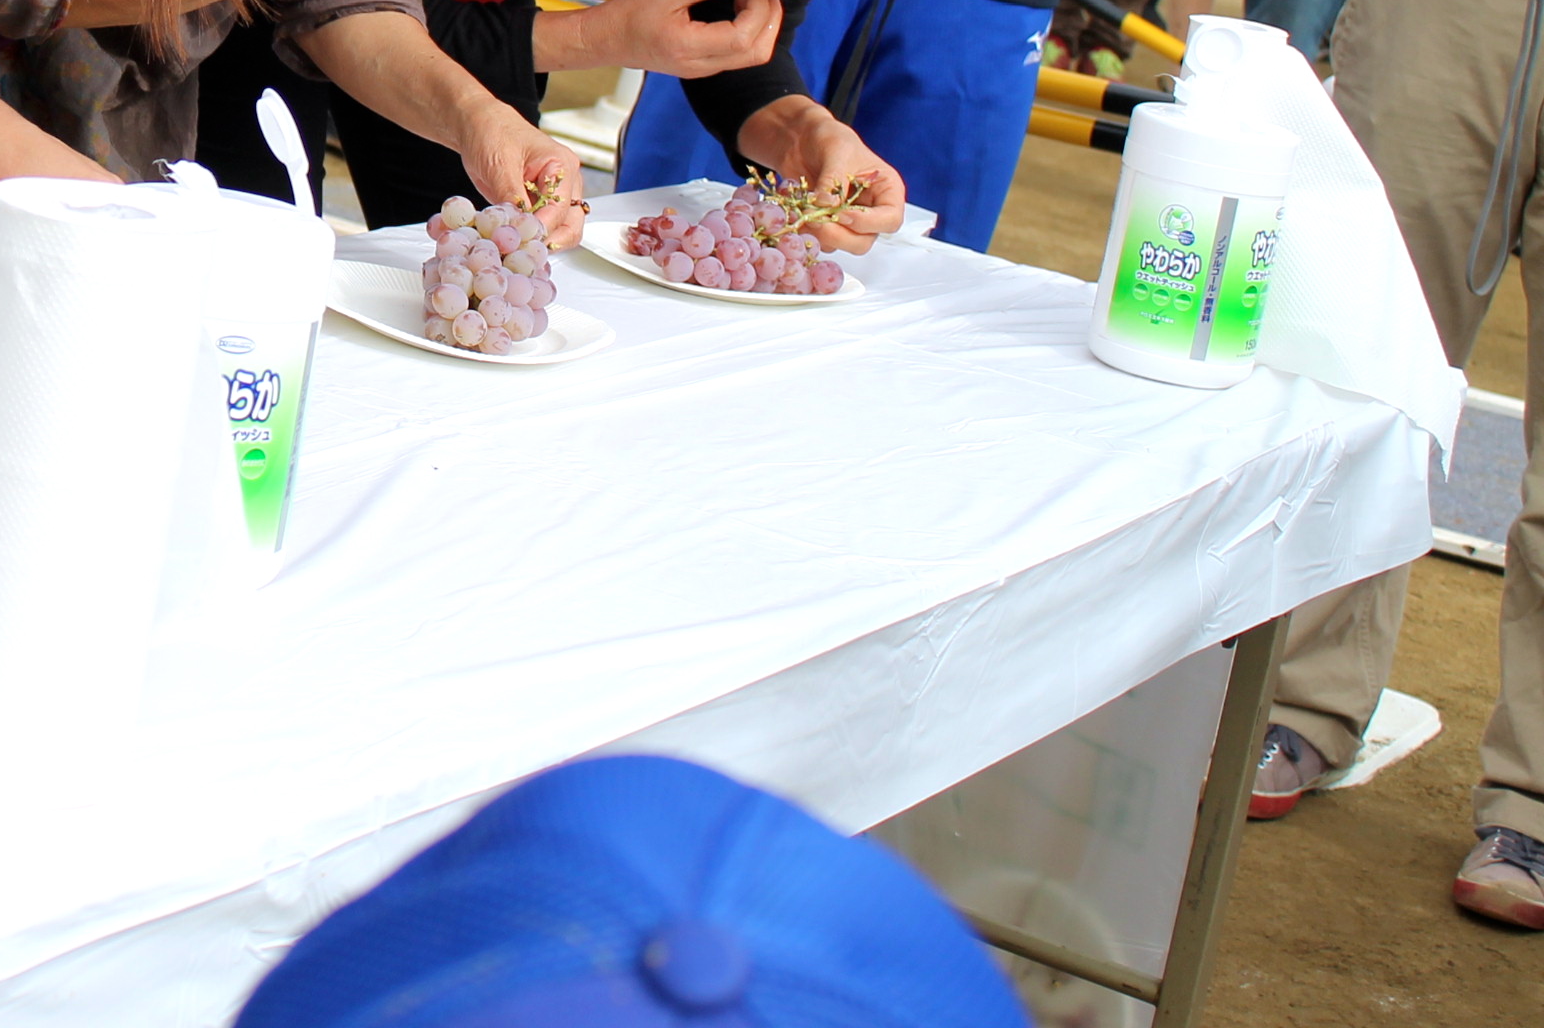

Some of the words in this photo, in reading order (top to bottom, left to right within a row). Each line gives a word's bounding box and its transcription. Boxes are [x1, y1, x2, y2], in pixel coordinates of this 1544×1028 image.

[1140, 240, 1202, 281] やわらか
[1201, 235, 1229, 324] ノンアルコール・無香料
[221, 369, 281, 422] らか
